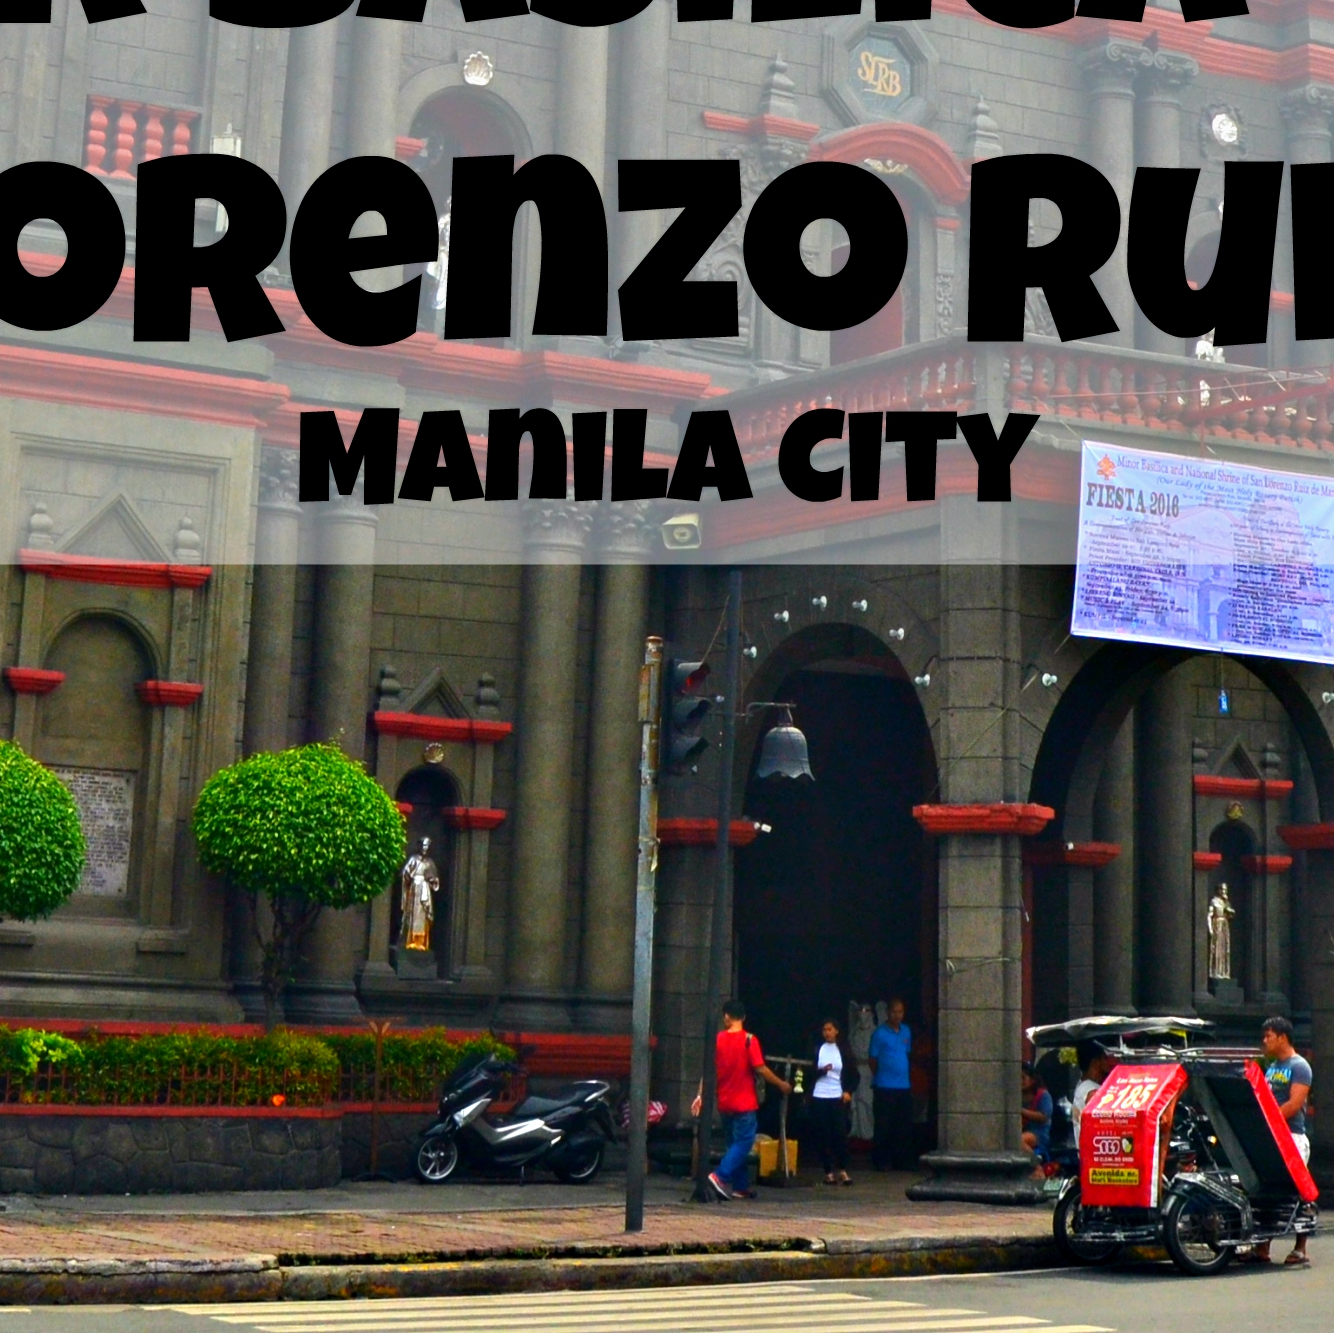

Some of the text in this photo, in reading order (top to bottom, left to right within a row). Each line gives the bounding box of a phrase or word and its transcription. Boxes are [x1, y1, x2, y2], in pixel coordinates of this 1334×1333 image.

[1117, 455, 1140, 470] Minor
[1142, 458, 1168, 473] Basilica
[1171, 463, 1184, 475] and
[1186, 466, 1216, 480] National
[1218, 469, 1240, 484] Shrine
[1242, 473, 1250, 485] of
[1250, 474, 1263, 487] San
[1264, 475, 1292, 491] Lorenzo
[1294, 480, 1309, 492] Ruiz
[1311, 483, 1320, 494] de
[1086, 482, 1146, 513] FIESTA
[1092, 1169, 1124, 1177] Avenida
